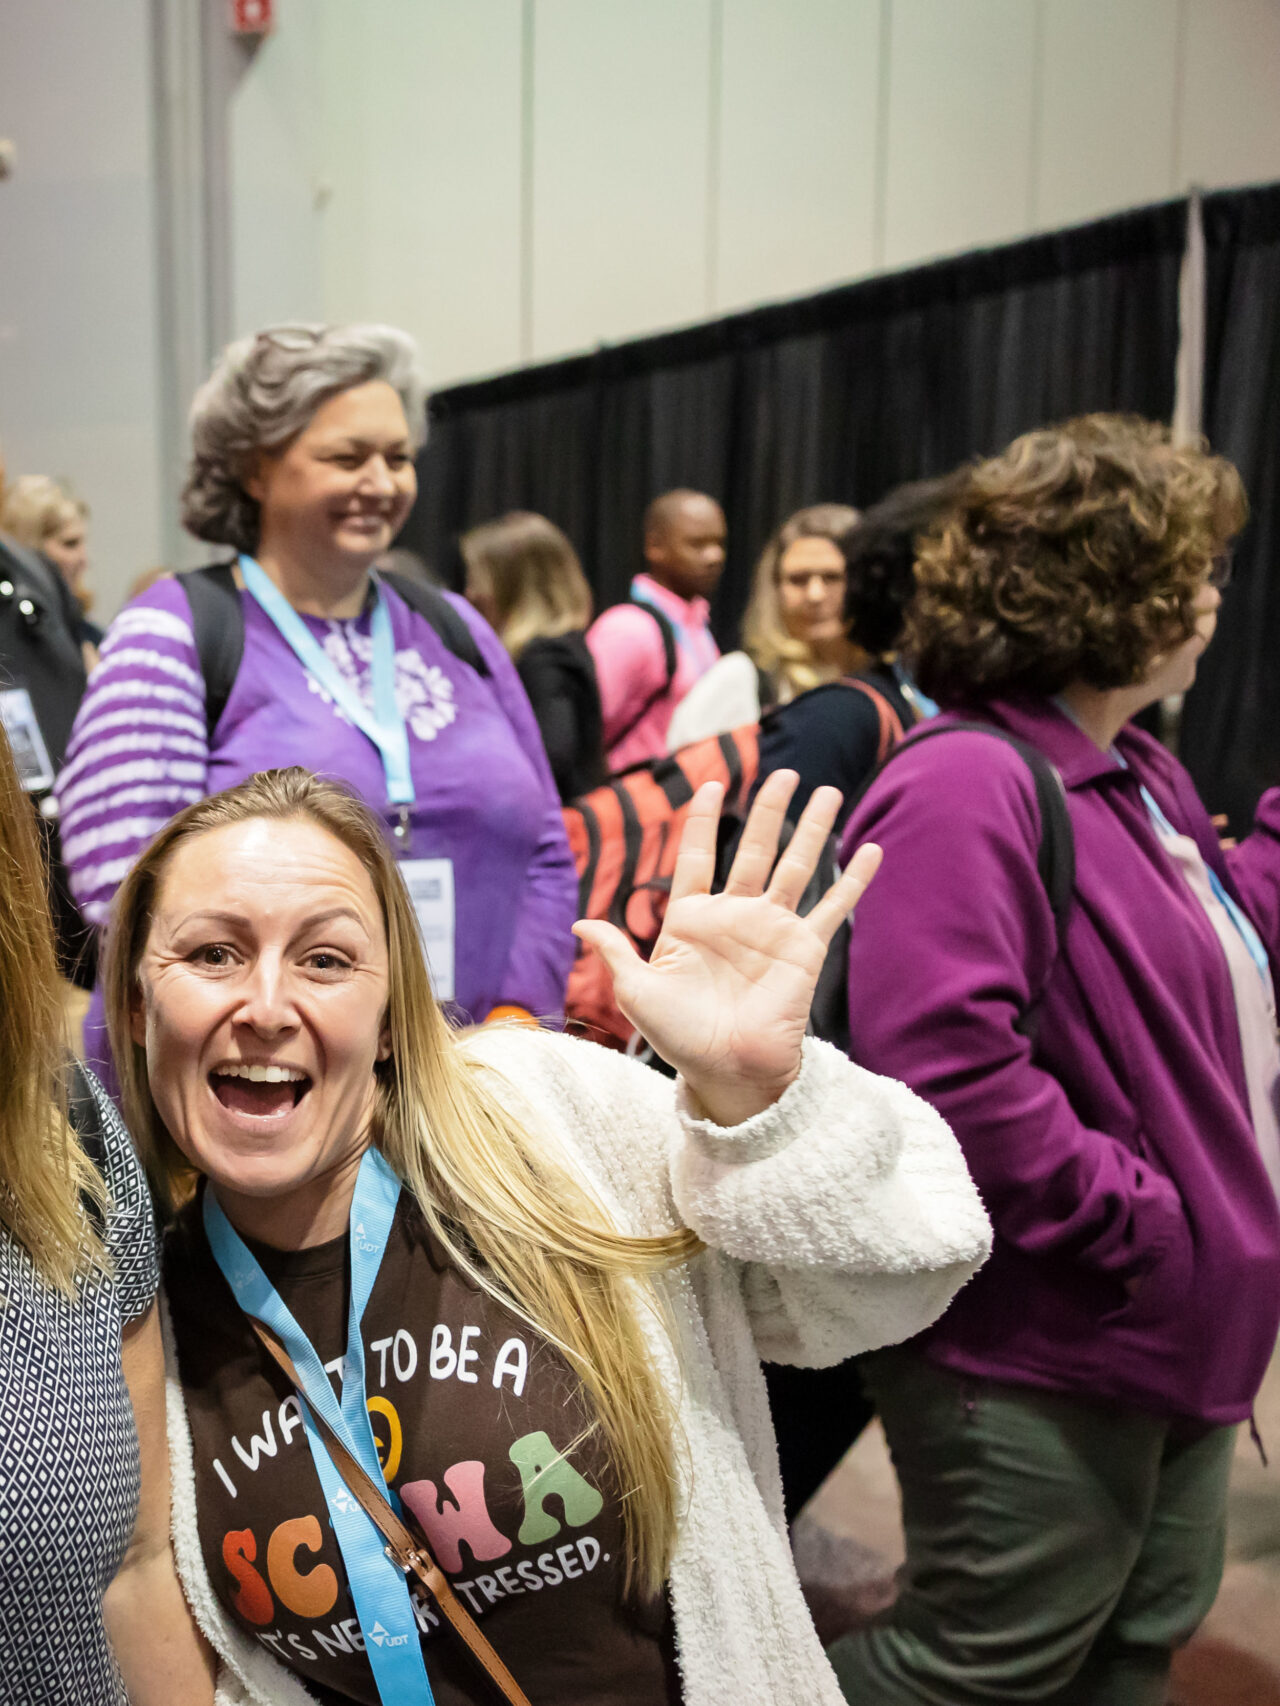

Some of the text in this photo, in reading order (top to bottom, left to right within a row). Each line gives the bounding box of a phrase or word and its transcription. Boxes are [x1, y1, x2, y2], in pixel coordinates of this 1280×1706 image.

[359, 1239, 380, 1253] UDT
[213, 1458, 237, 1498] I
[370, 1329, 418, 1388] TO
[429, 1324, 481, 1384] BE
[492, 1337, 528, 1396] A
[222, 1431, 604, 1626] SCWA
[454, 1536, 611, 1615] TRESSED.
[385, 1634, 409, 1648] UDT
